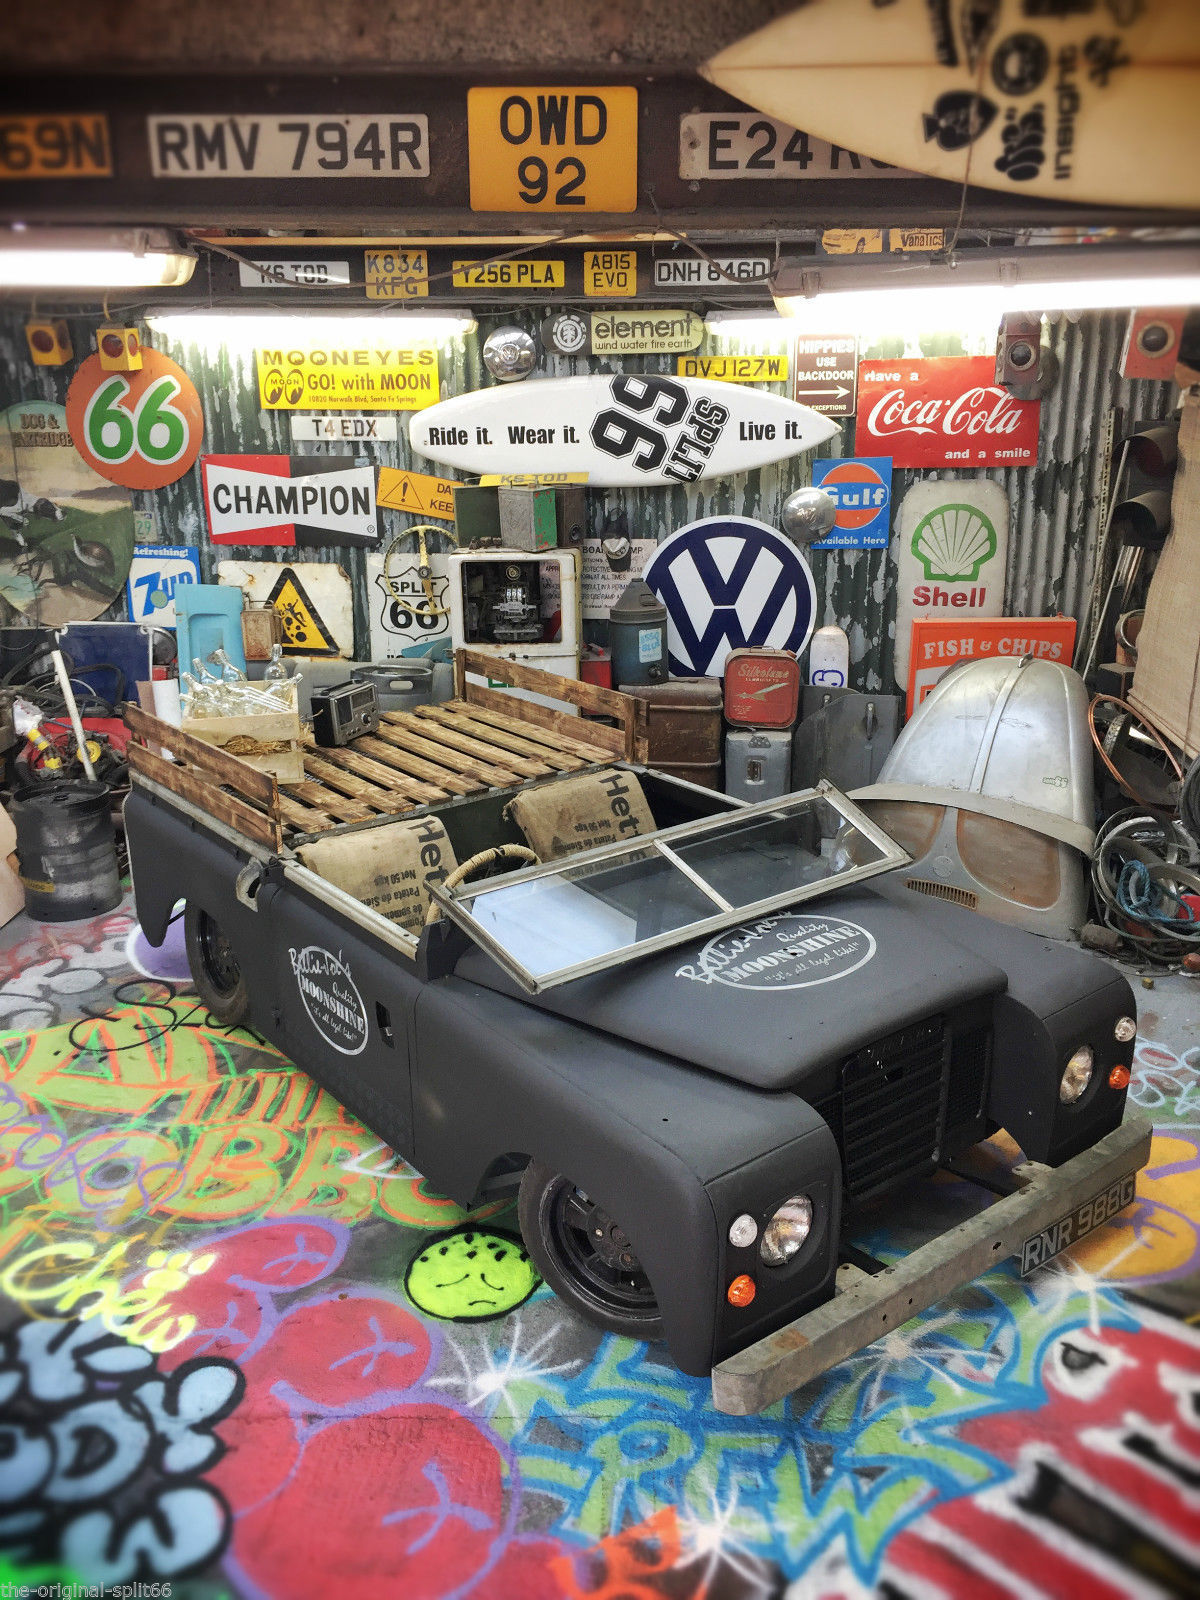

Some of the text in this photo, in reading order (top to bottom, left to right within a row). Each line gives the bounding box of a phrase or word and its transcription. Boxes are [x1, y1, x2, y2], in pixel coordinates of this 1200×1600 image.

[500, 95, 607, 145] OWD
[156, 122, 422, 171] RMV 794R
[708, 120, 813, 170] E24
[518, 156, 586, 205] 92
[367, 254, 424, 273] K834
[591, 254, 630, 270] A815
[658, 261, 766, 281] DNH 846D
[291, 264, 328, 284] TOD
[461, 264, 555, 283] Y256 PLA
[593, 272, 627, 287] EVO
[376, 276, 418, 295] KFG
[594, 313, 693, 339] element
[594, 339, 693, 350] wind water fire earth
[799, 339, 855, 353] HIPPIES
[263, 350, 434, 366] MOONEYES
[685, 359, 780, 377] DVJ 127W
[816, 356, 837, 367] USE
[308, 373, 431, 390] GO! with MOON
[798, 370, 854, 381] BACKDOOR
[864, 370, 919, 382] Have a
[84, 375, 190, 466] 66
[867, 386, 1024, 436] Coca-Cola
[311, 418, 377, 437] T4 EDX
[428, 424, 580, 446] Ride it. Wear it.
[739, 420, 803, 441] Live it.
[662, 396, 730, 482] SPLIT
[945, 448, 1031, 459] and a smile
[213, 483, 371, 516] CHAMPION
[819, 486, 885, 506] Gulf
[814, 536, 886, 545] Available Here
[912, 585, 986, 608] Shell
[390, 600, 439, 630] 66
[924, 638, 1063, 660] FISH & CHIPS
[401, 869, 417, 880] Net
[381, 893, 392, 904] de
[413, 904, 423, 914] de
[776, 922, 830, 942] Quality
[721, 926, 861, 983] MOONSHINE
[301, 974, 365, 1035] MOONSHINE
[1025, 1217, 1073, 1270] RNR
